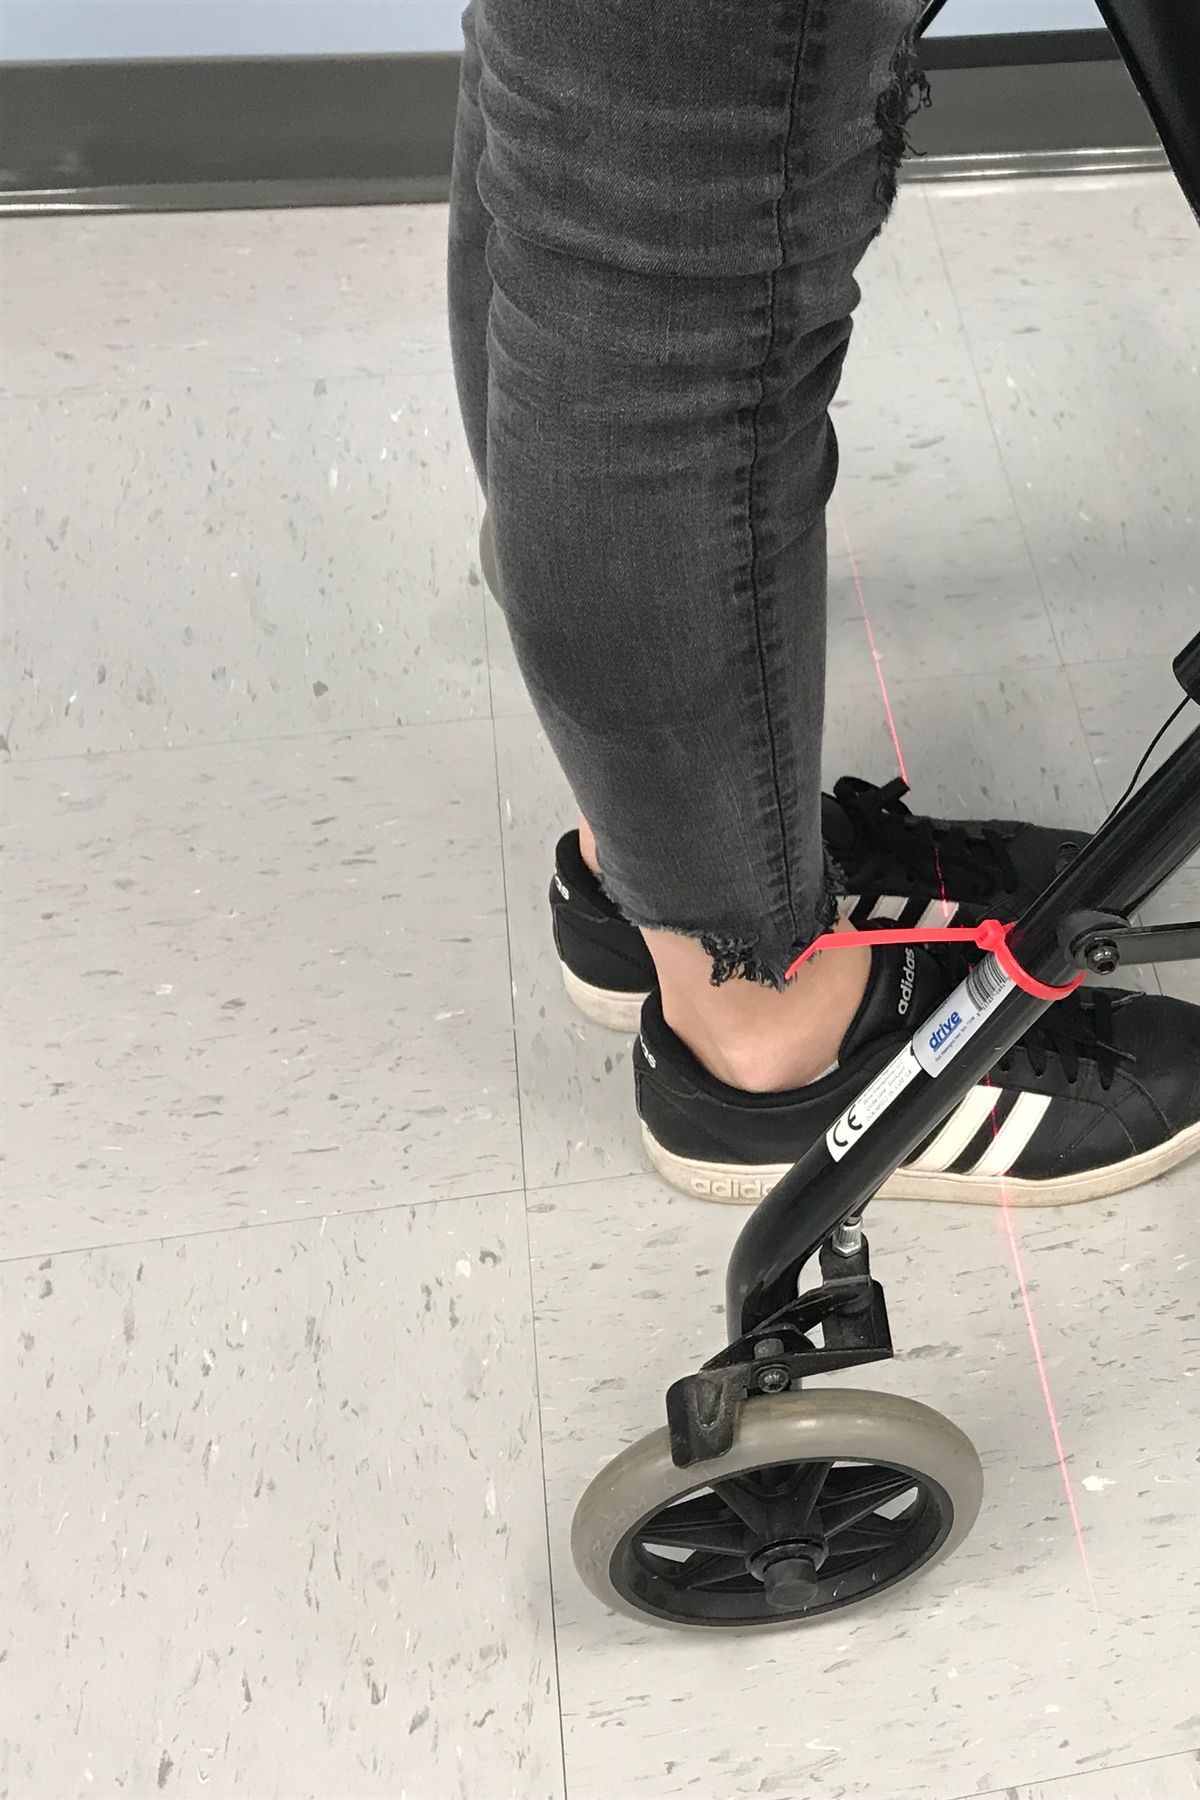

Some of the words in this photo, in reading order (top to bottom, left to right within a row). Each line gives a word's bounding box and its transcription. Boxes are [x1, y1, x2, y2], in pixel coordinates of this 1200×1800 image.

[898, 947, 915, 1015] adidas
[929, 1011, 961, 1050] drive
[690, 1178, 776, 1199] adid
